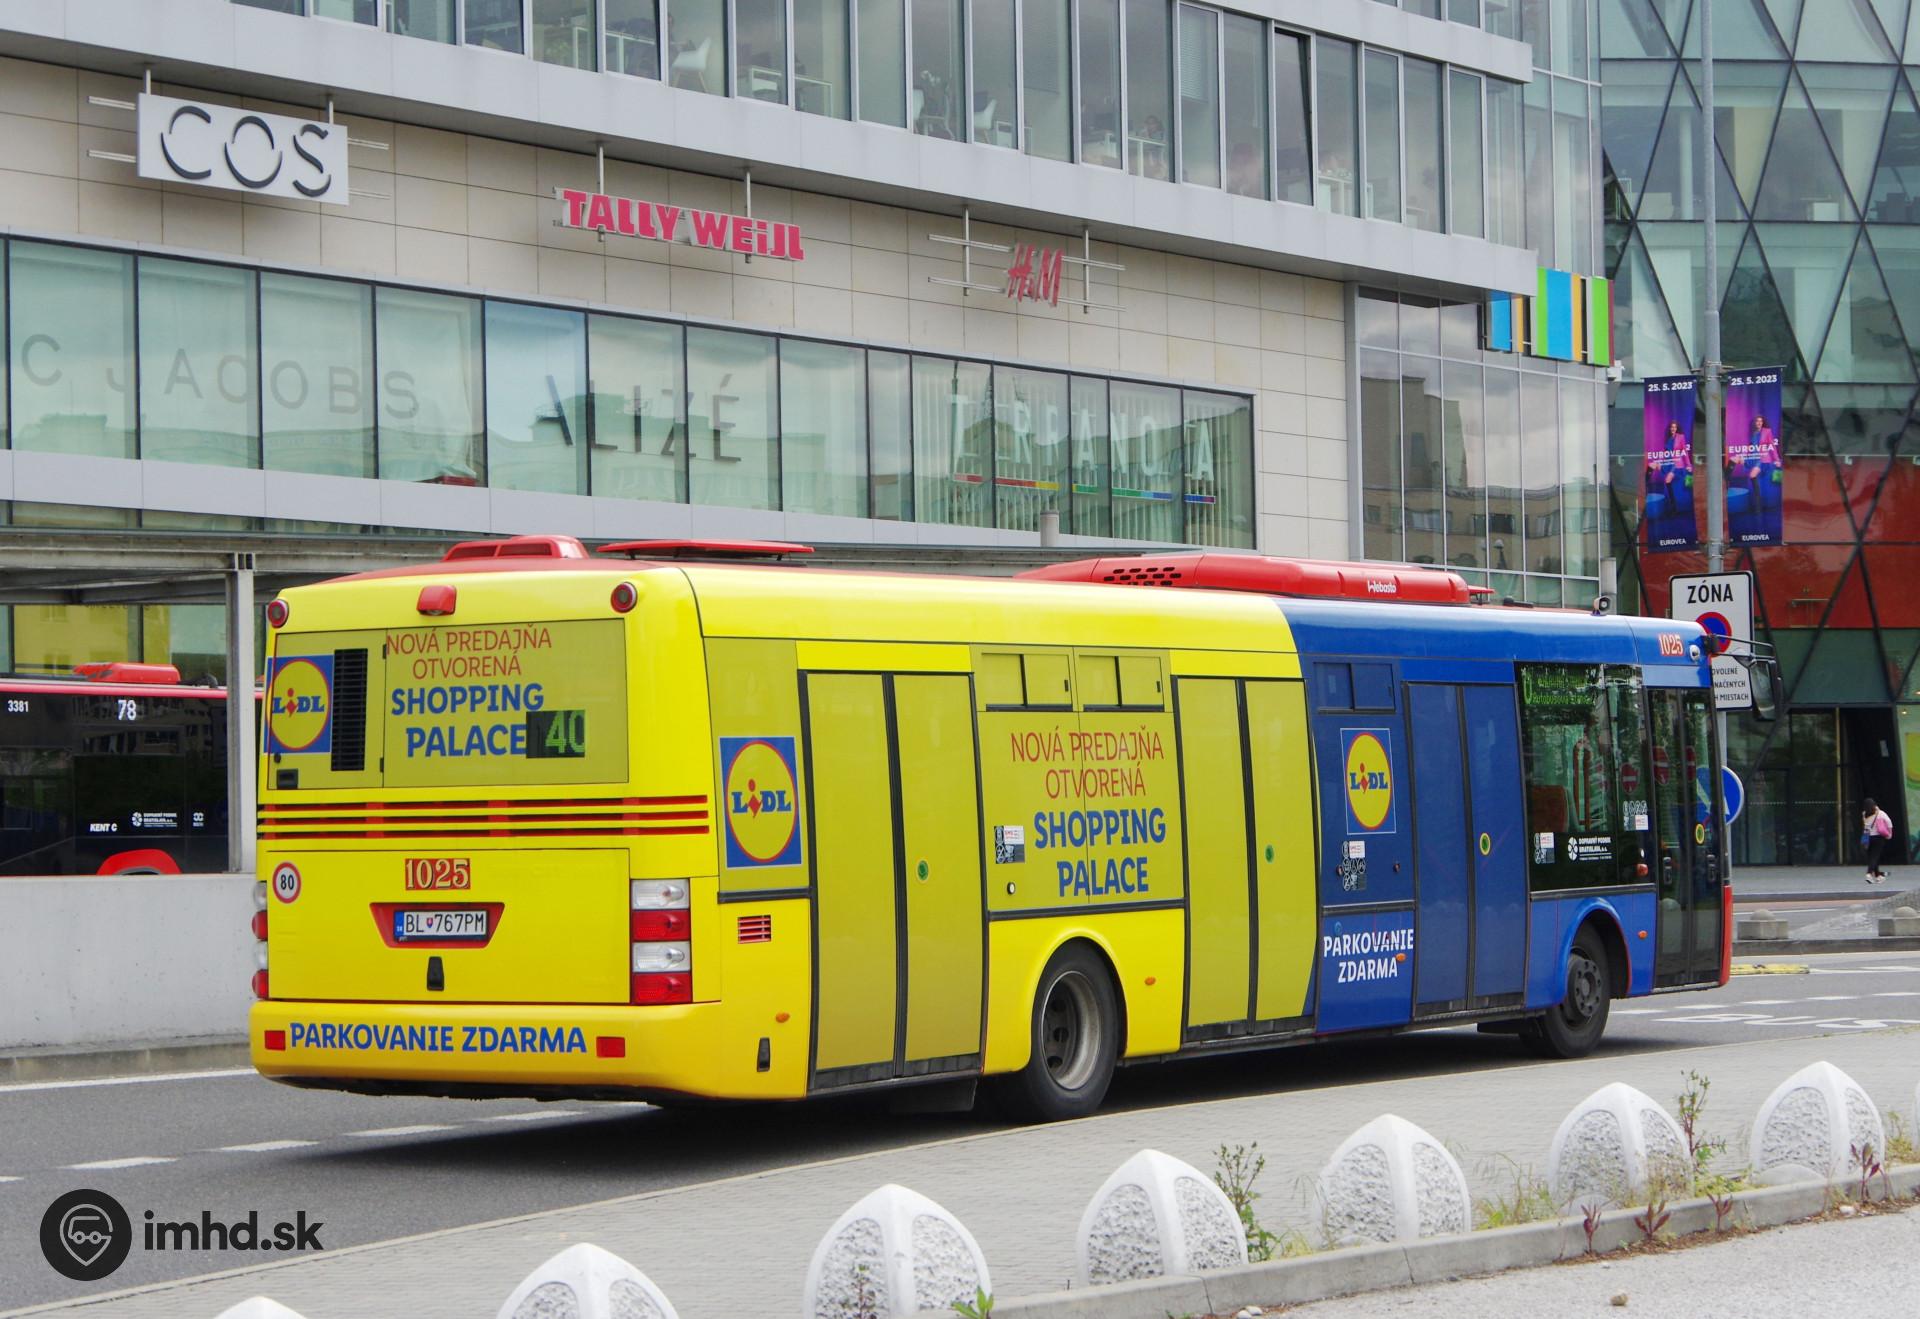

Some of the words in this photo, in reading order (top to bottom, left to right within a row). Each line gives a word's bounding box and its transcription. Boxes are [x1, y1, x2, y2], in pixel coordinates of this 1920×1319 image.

[160, 105, 332, 198] COS
[563, 189, 681, 241] TALLY
[1007, 243, 1065, 308] H&M
[1671, 381, 1693, 390] 2023
[1756, 374, 1777, 384] 2023
[948, 393, 1214, 482] TRRANOA
[1660, 538, 1686, 546] EUROVEA
[1367, 580, 1397, 593] Webasto
[1687, 579, 1734, 604] ZÓNA
[386, 627, 440, 656] NOVÁ
[445, 623, 552, 652] PREDAJŇA
[1659, 633, 1684, 655] 1025
[412, 650, 522, 680] OTVORENÁ
[8, 700, 29, 712] 3381
[118, 700, 136, 720] 78
[391, 683, 544, 716] SHOPPING
[1720, 693, 1749, 701] MIESTACH
[406, 723, 527, 758] PALACE
[545, 710, 585, 753] 40
[1010, 725, 1065, 762] NOVÁ
[1069, 725, 1164, 762] PREDAJŇA
[1046, 761, 1146, 799] OTVORENÁ
[90, 823, 110, 832] KENT
[1034, 807, 1166, 849] SHOPPING
[280, 874, 295, 890] 80
[406, 859, 469, 889] 1025
[1057, 857, 1149, 897] PALACE
[406, 914, 424, 933] BL
[434, 914, 484, 933] 767PM
[1323, 928, 1414, 957] PARKOVANIE
[1338, 956, 1398, 983] ZDARMA
[290, 1022, 454, 1052] PARKOVANIE
[462, 1026, 587, 1053] ZDARMA
